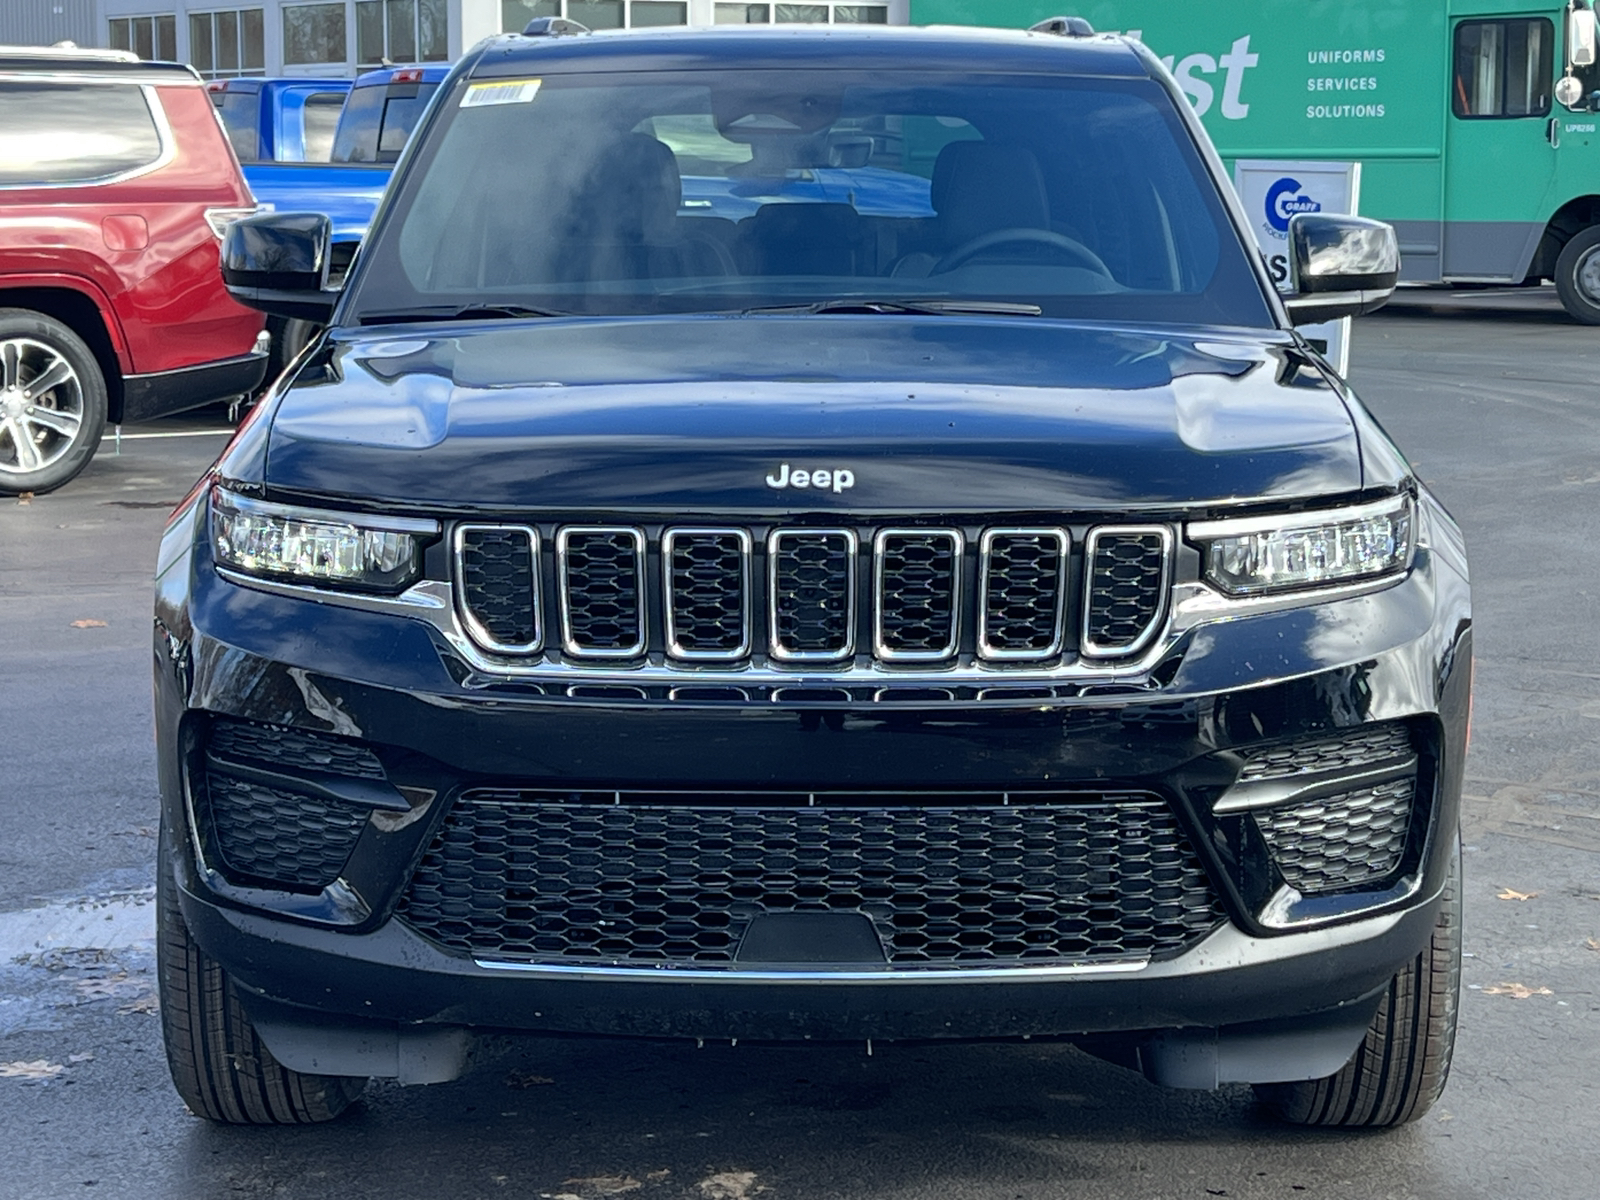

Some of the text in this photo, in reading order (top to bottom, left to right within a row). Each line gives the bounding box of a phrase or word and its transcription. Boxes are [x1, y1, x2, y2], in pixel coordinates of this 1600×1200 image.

[1307, 49, 1385, 64] UNIFORMS
[1307, 77, 1377, 91] SERVICES
[1306, 104, 1385, 118] SOLUTIONS
[1285, 202, 1317, 212] GRAFF
[766, 464, 855, 493] Jeep
